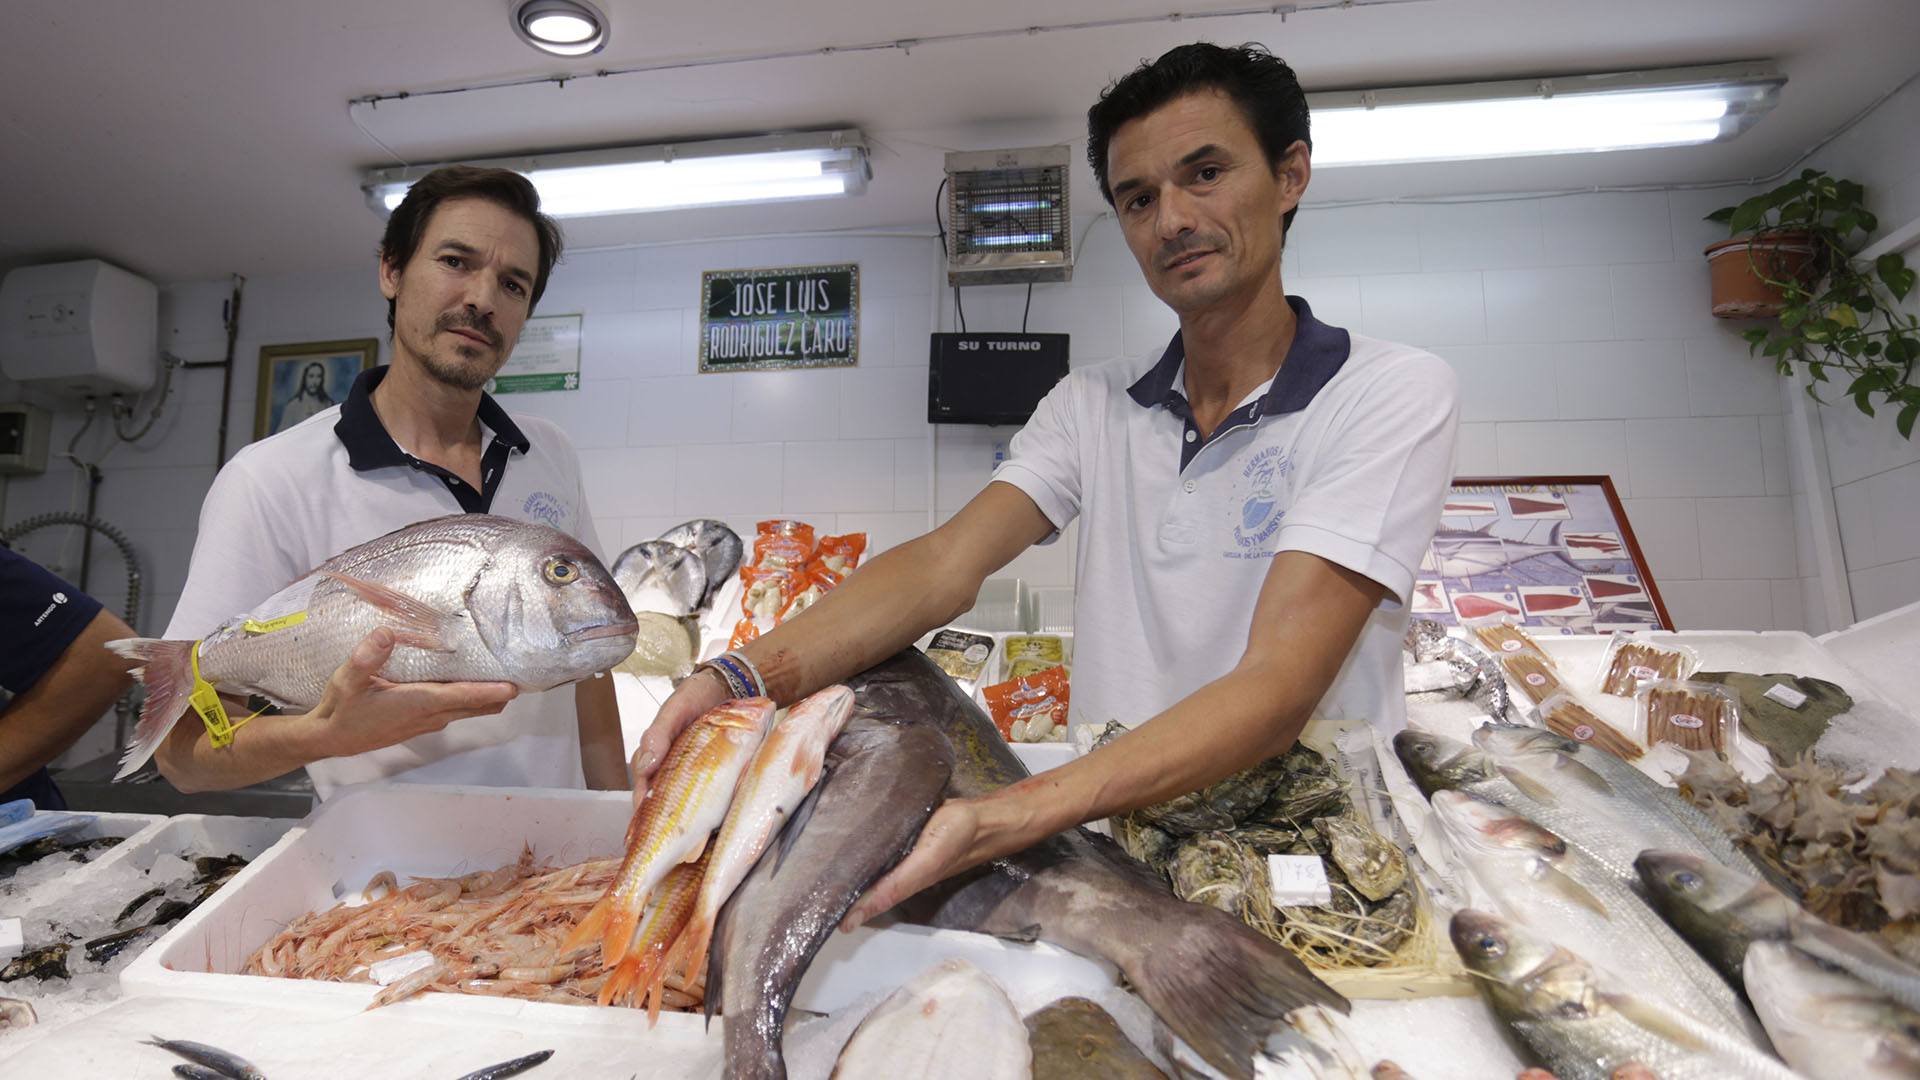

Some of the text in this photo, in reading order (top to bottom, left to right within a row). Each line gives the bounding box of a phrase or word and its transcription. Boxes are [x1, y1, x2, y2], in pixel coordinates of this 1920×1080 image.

[730, 279, 830, 317] JOSE LUIS
[710, 321, 795, 359] RODRIGUEZ
[958, 341, 1041, 351] SU TURNO
[34, 603, 57, 627] ARTENGO
